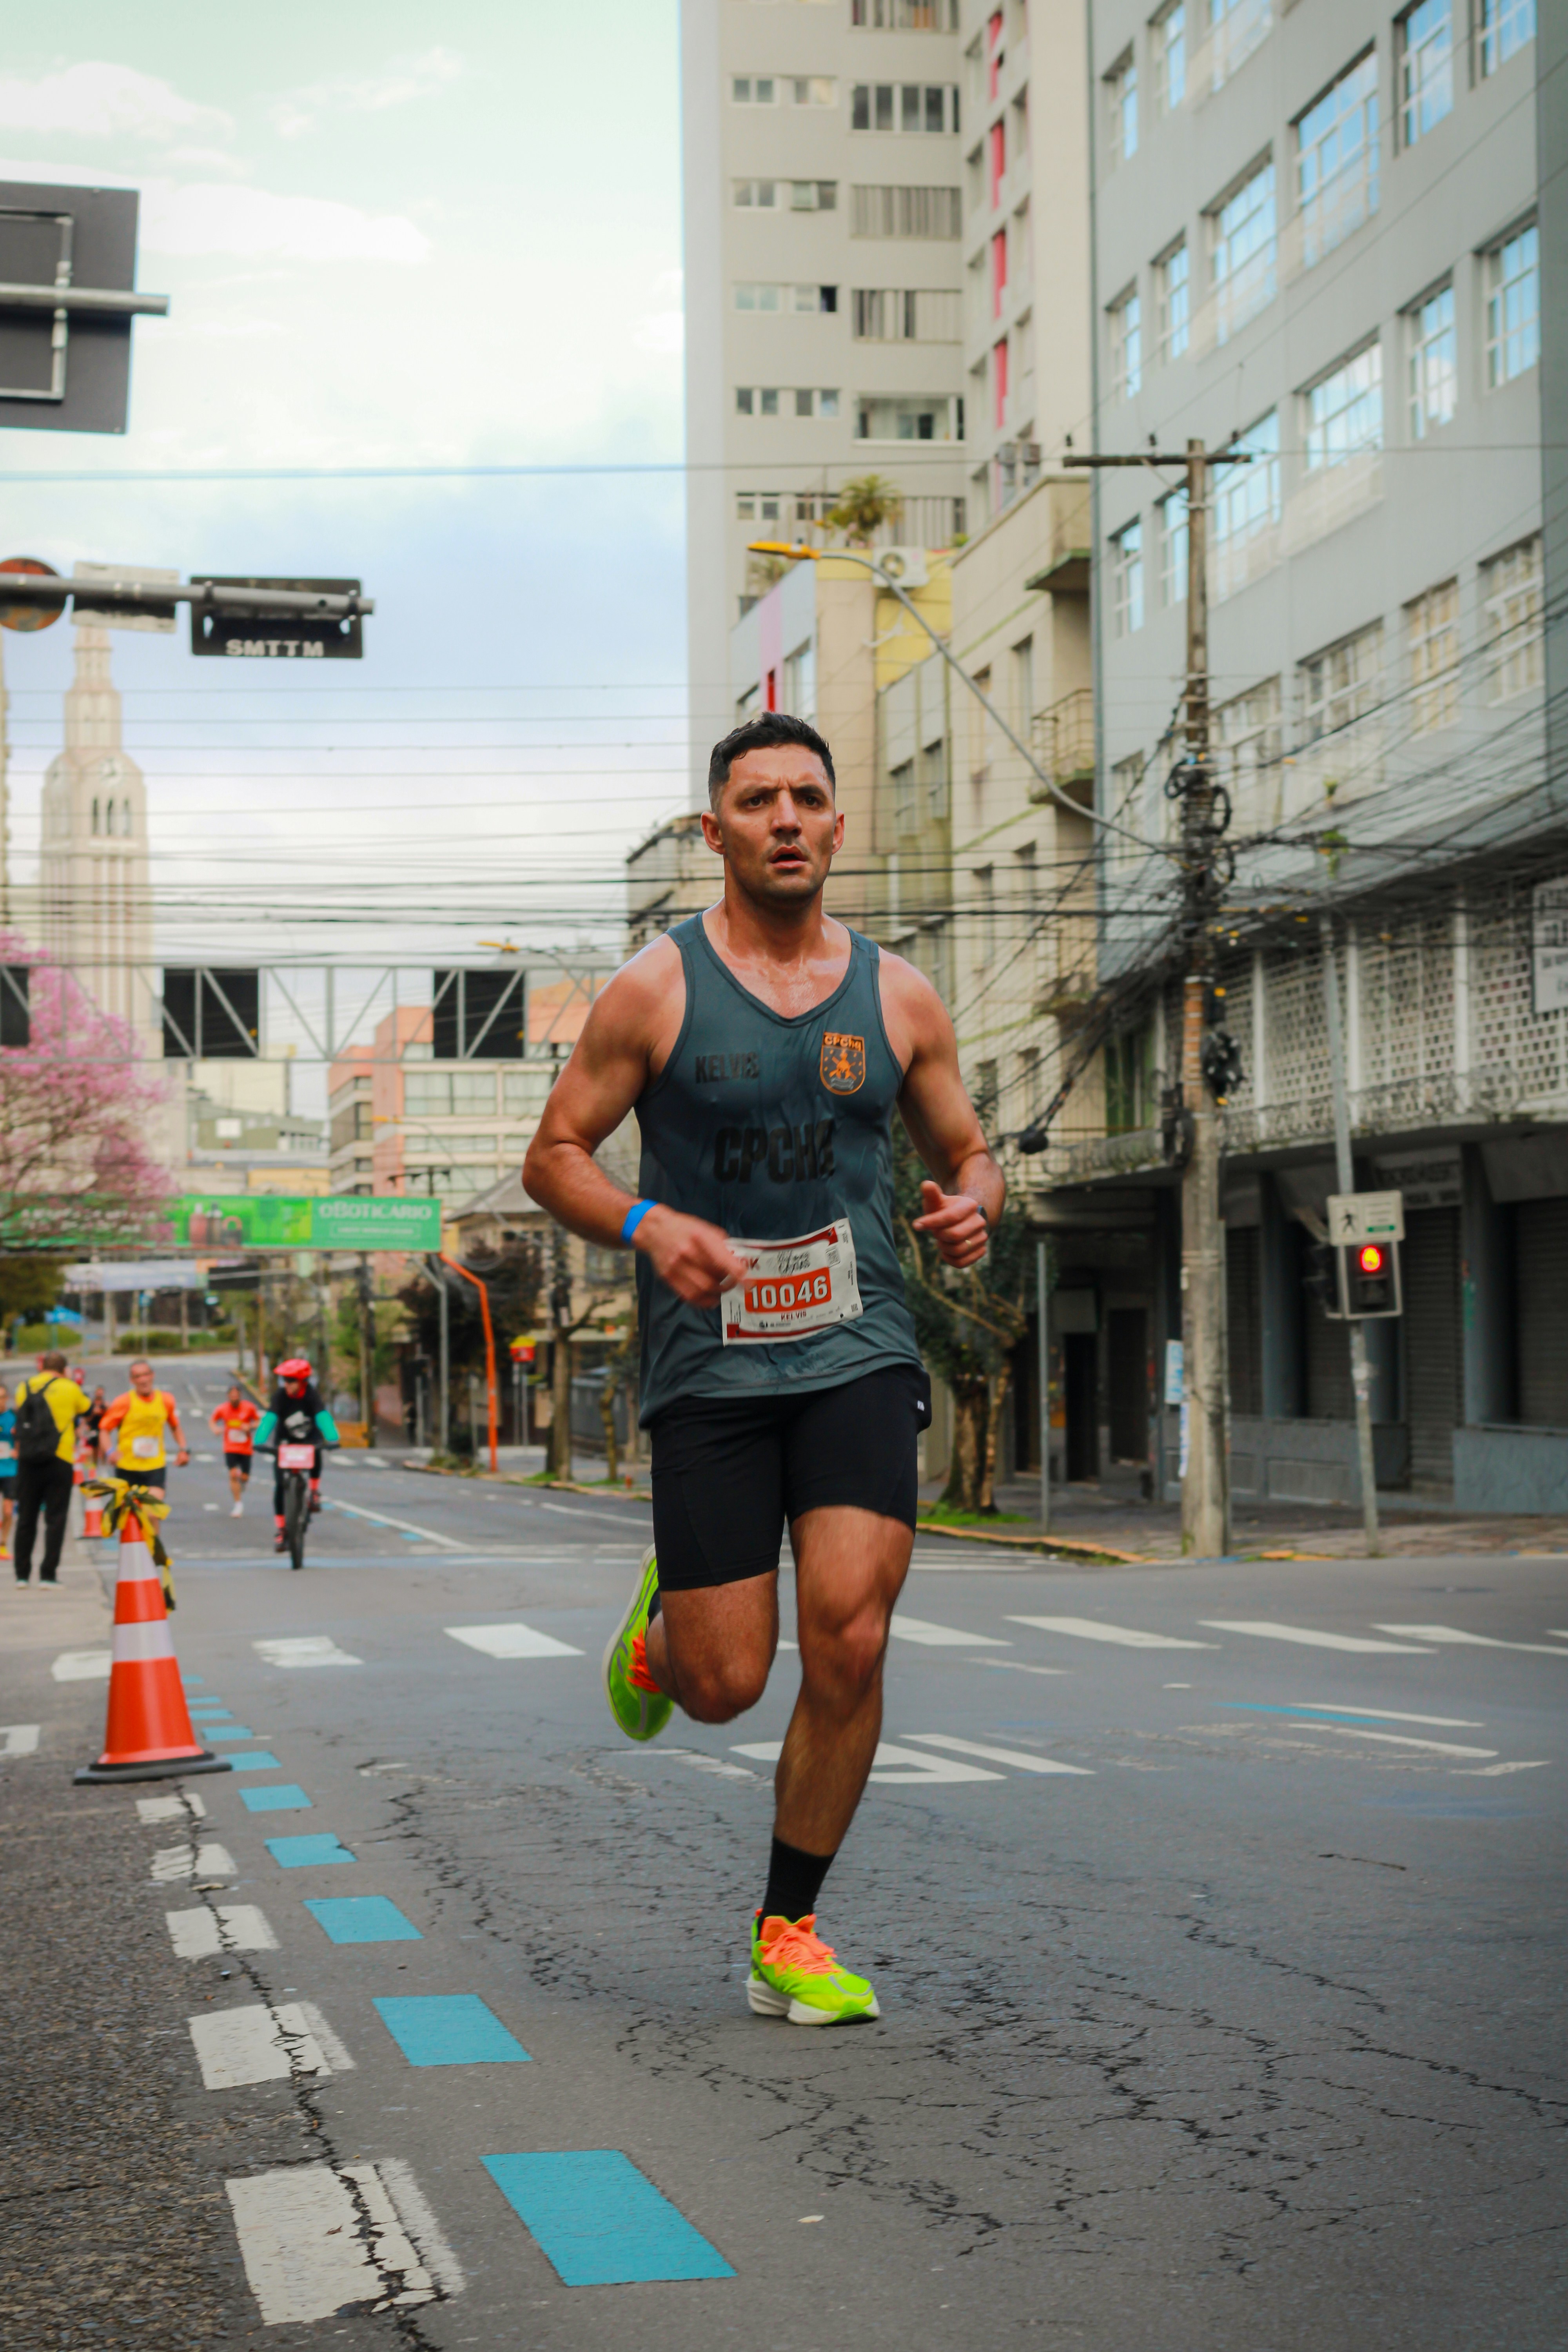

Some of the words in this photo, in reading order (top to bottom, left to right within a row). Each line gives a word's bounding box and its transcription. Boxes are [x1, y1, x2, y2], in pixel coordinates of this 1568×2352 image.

[226, 639, 324, 657] SMTTM
[695, 1052, 759, 1083] KELVIS
[750, 1276, 828, 1308] 10046
[780, 1311, 807, 1321] KELVIS
